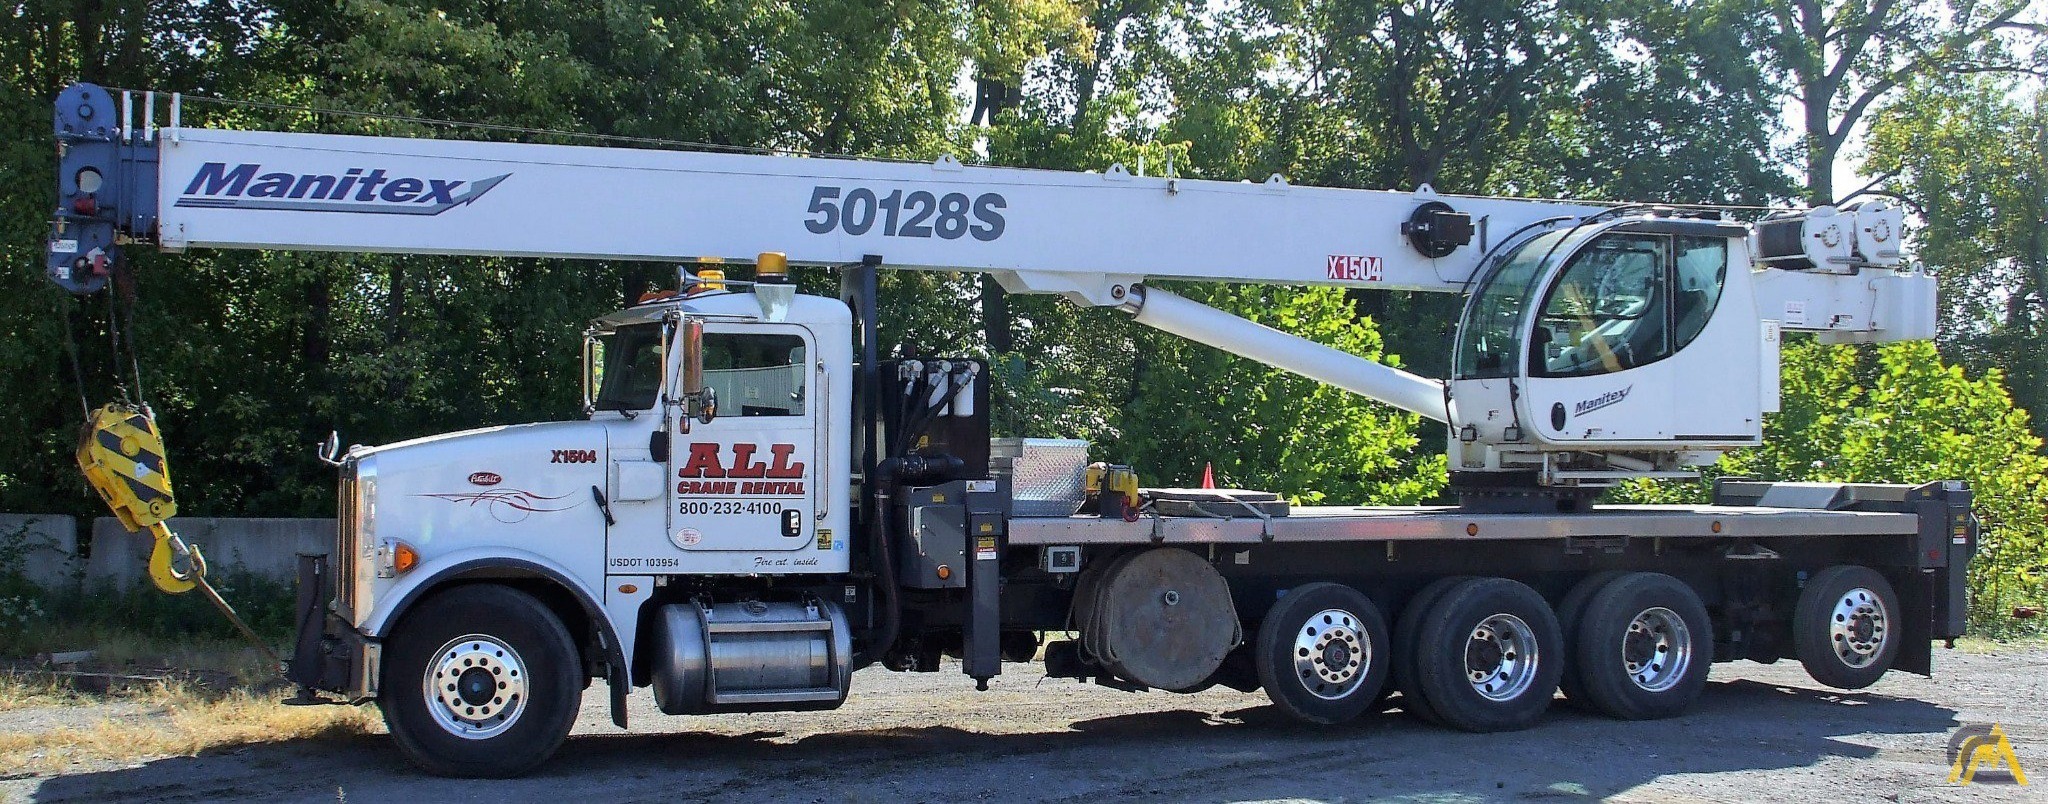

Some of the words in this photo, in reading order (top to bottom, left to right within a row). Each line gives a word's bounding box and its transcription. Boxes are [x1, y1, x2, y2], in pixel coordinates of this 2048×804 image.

[183, 162, 466, 204] Manitex
[803, 186, 1007, 241] 50128S
[1328, 255, 1383, 281] X1504
[1575, 389, 1626, 413] Manitex
[550, 450, 597, 463] X1504
[678, 443, 805, 478] ALL
[677, 481, 737, 494] CRANE
[740, 481, 805, 494] RENTAL
[610, 558, 642, 567] USDOT
[645, 558, 679, 567] 103954
[755, 557, 772, 568] Fire
[793, 557, 819, 566] inside
